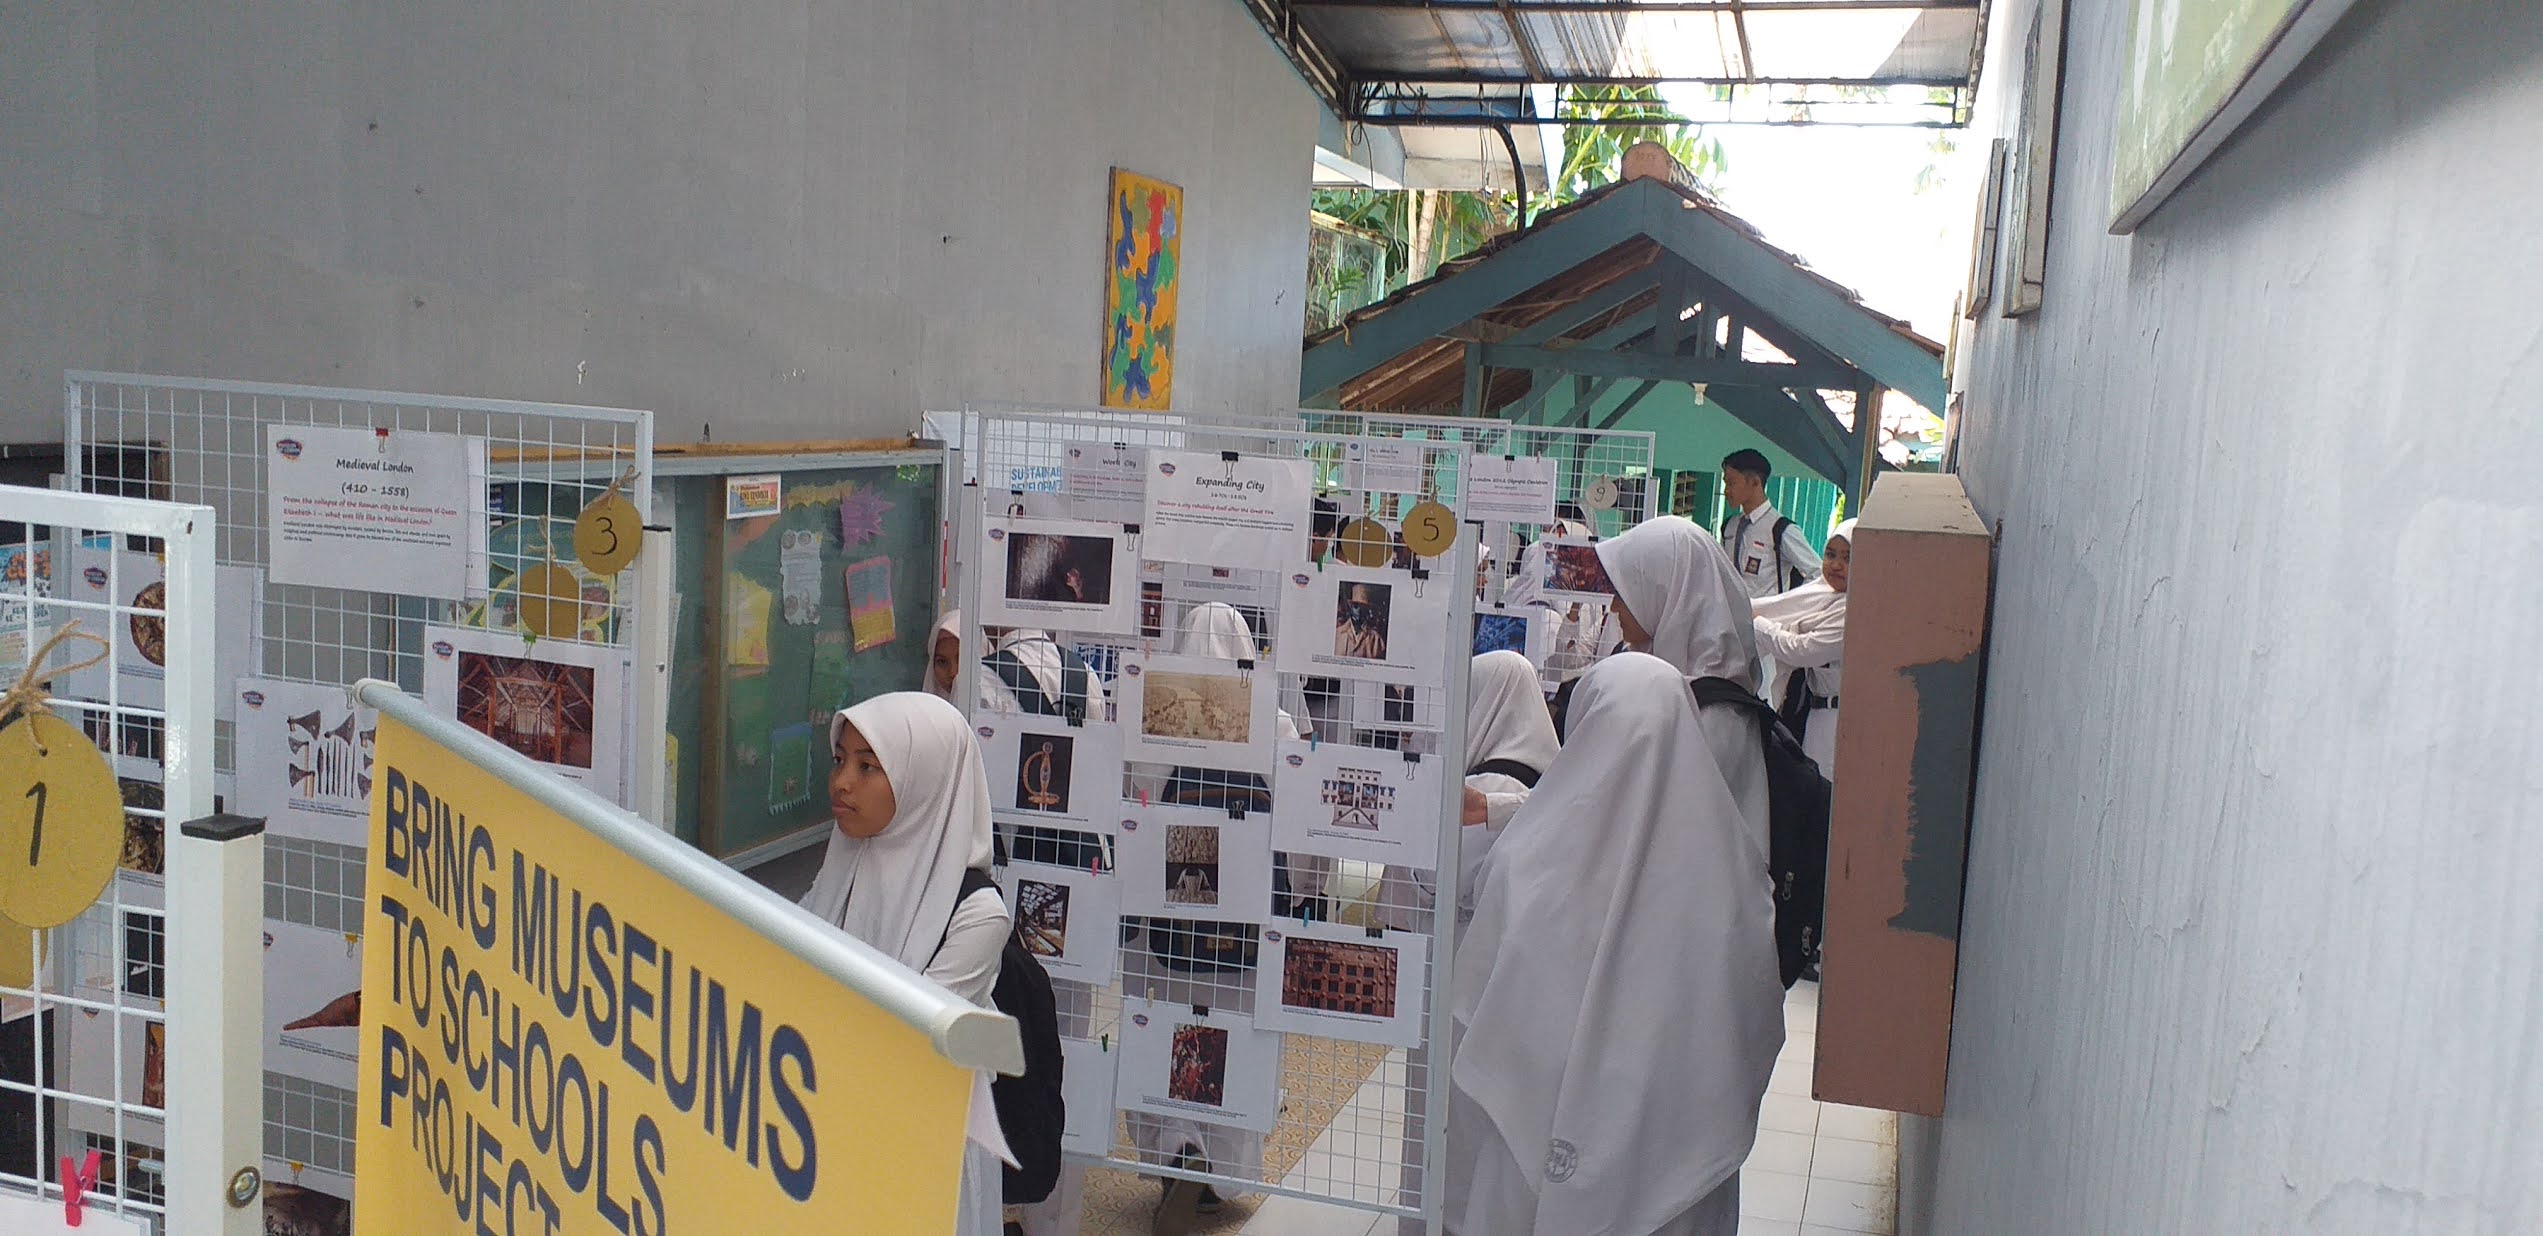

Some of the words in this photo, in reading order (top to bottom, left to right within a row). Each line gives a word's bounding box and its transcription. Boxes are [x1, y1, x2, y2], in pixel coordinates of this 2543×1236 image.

[336, 458, 380, 472] Medieval
[382, 460, 414, 474] London
[341, 482, 368, 495] (410
[380, 485, 410, 500] 1558)
[1195, 476, 1243, 491] Expanding
[1246, 480, 1265, 493] City
[1596, 486, 1606, 502] 9
[302, 496, 313, 504] the
[346, 499, 357, 507] the
[591, 516, 619, 556] 3
[1422, 517, 1440, 542] 5
[25, 781, 47, 867] 1
[384, 765, 497, 950] BRING
[511, 848, 818, 1202] MUSEUMS
[380, 894, 432, 1029] TO
[440, 945, 666, 1236] SCHOOLS
